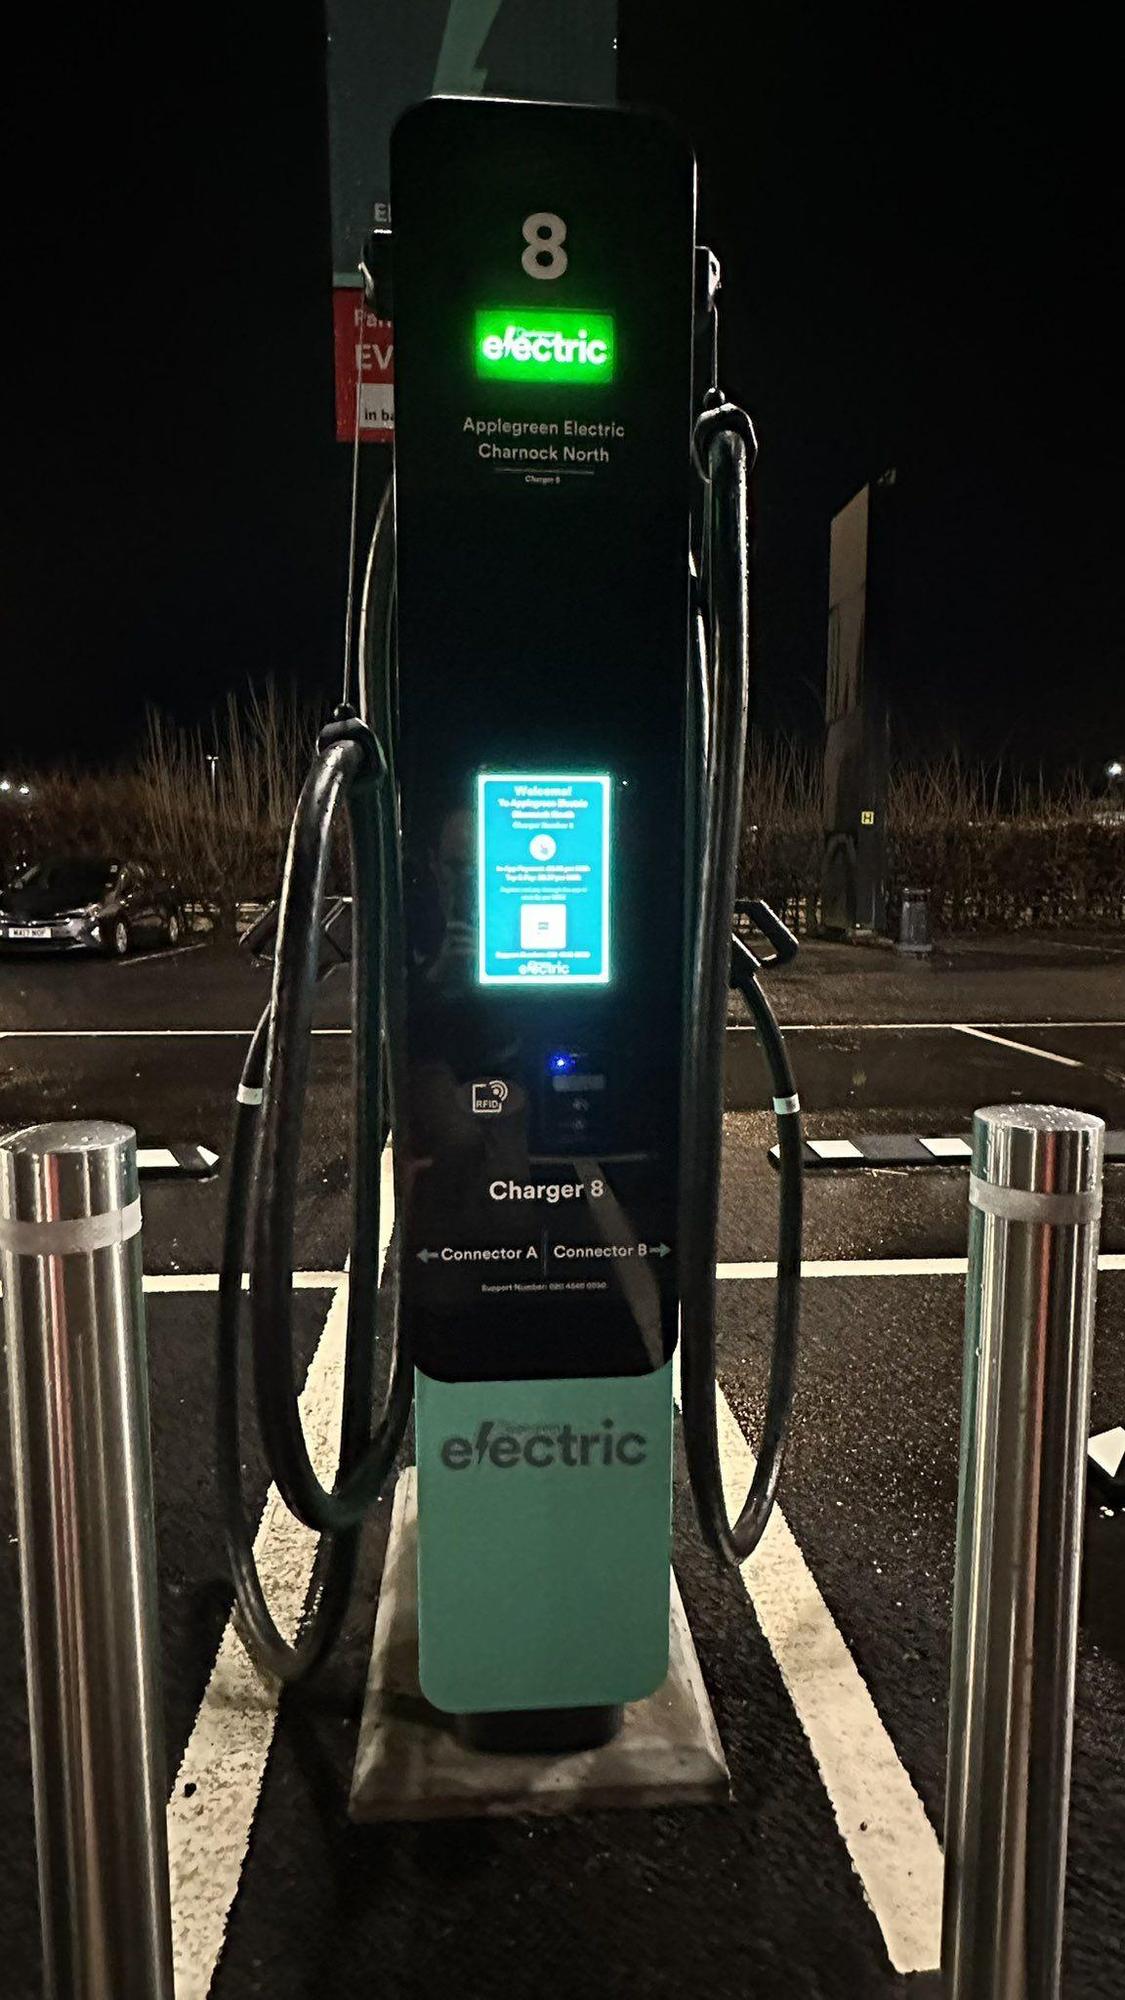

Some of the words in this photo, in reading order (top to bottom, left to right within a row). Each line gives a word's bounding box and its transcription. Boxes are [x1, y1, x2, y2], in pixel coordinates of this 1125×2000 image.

[521, 212, 568, 280] 8
[482, 325, 608, 365] electric
[364, 407, 377, 421] in
[463, 417, 558, 437] Applegreen
[564, 420, 625, 437] Electric
[478, 443, 558, 461] Charnock
[563, 446, 609, 462] North
[475, 1099, 499, 1109] RFID
[489, 1180, 584, 1203] Charger
[590, 1180, 604, 1198] 8
[441, 1247, 522, 1261] Connector
[525, 1246, 538, 1259] A
[553, 1244, 634, 1259] Connector
[638, 1243, 648, 1257] B
[440, 1418, 647, 1470] electric
